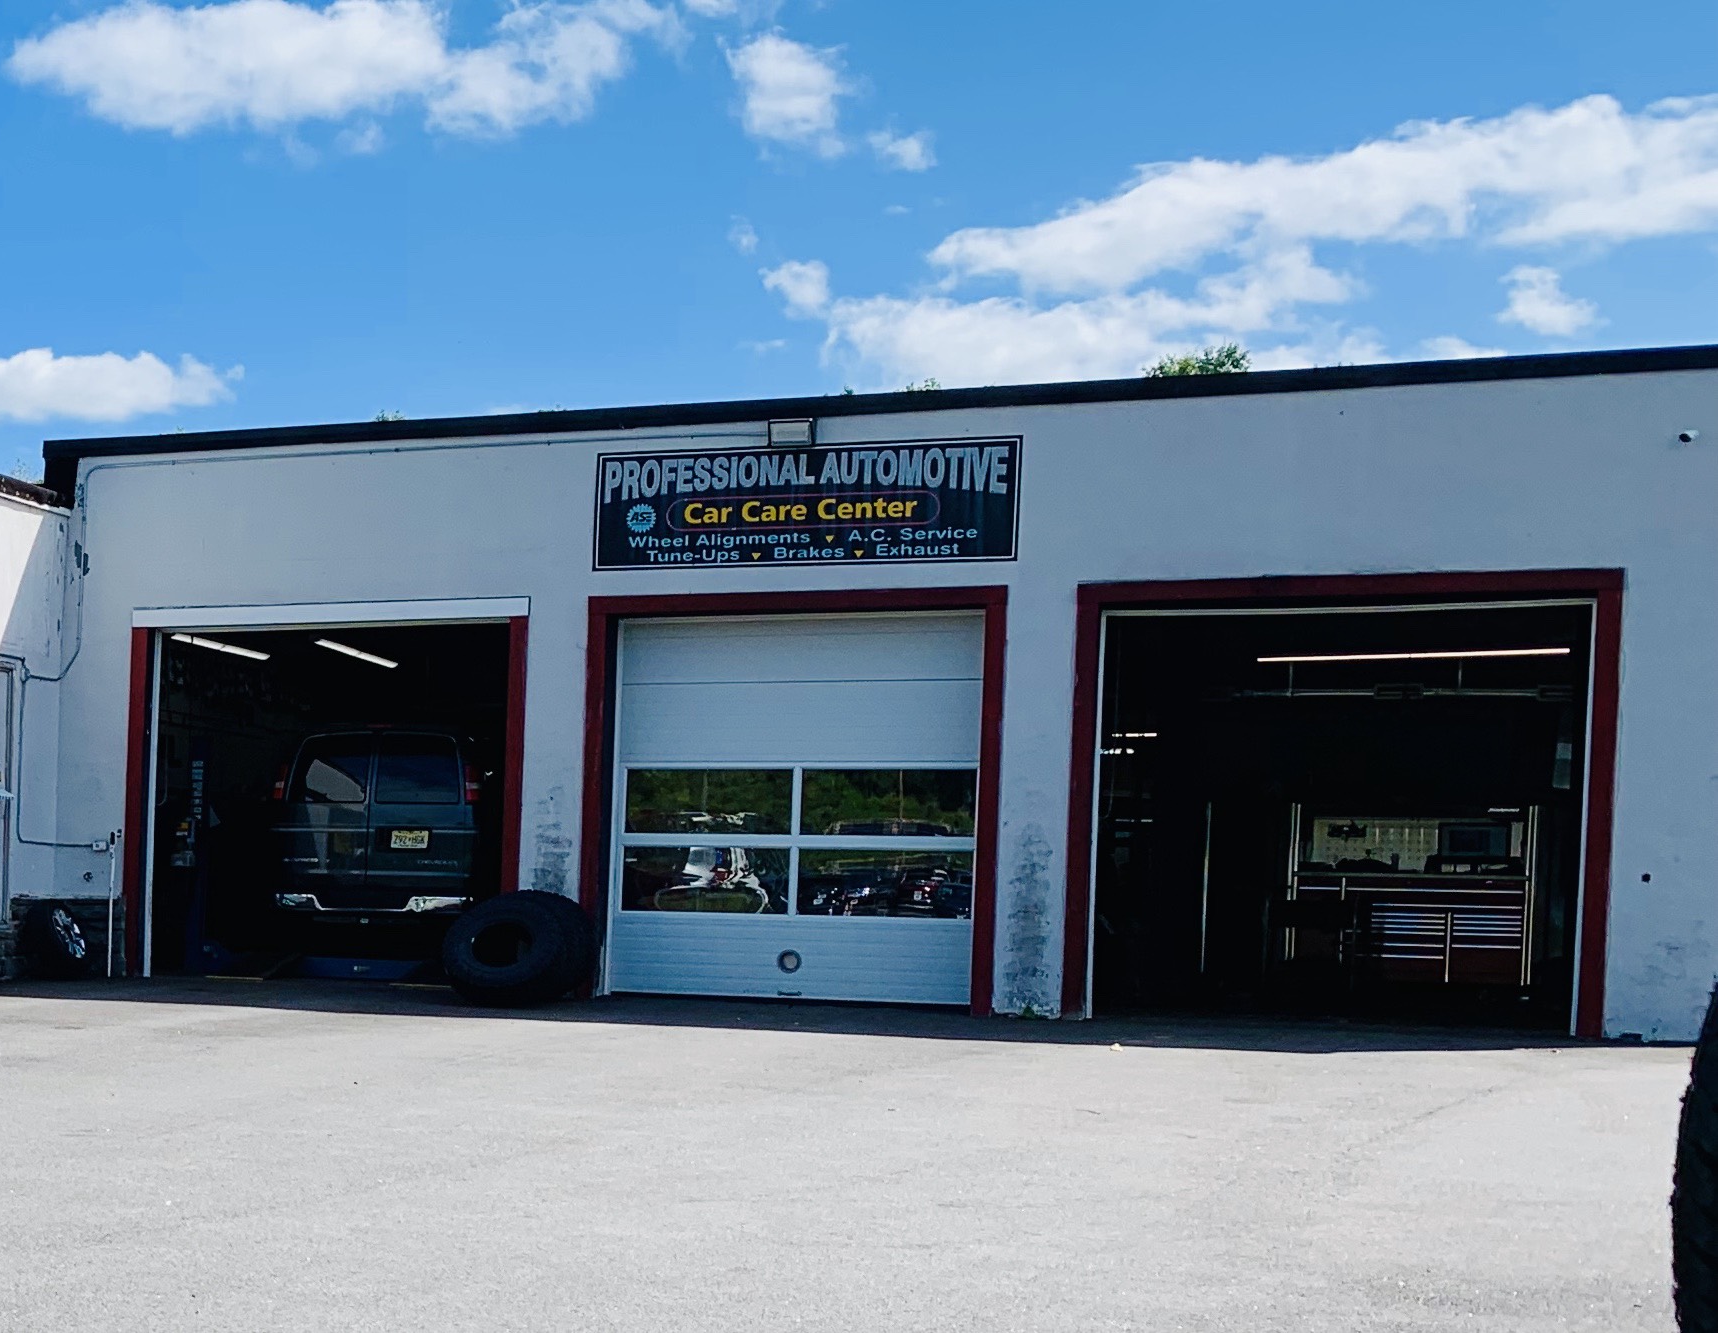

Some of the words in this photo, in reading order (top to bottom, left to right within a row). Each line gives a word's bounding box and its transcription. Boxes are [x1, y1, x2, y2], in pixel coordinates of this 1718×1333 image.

[604, 454, 815, 504] PROFESSIONAL
[819, 446, 1010, 494] AUTOMOTIVE
[630, 511, 652, 523] ASE
[684, 502, 732, 525] Car
[741, 501, 808, 523] Care
[817, 498, 918, 520] Center
[629, 534, 689, 549] Wheel
[695, 532, 811, 548] Alignments
[848, 529, 892, 542] A.C.
[899, 526, 978, 541] Service
[646, 549, 740, 564] Tune-Ups
[773, 546, 845, 560] Brakes
[875, 543, 960, 557] Exhaust
